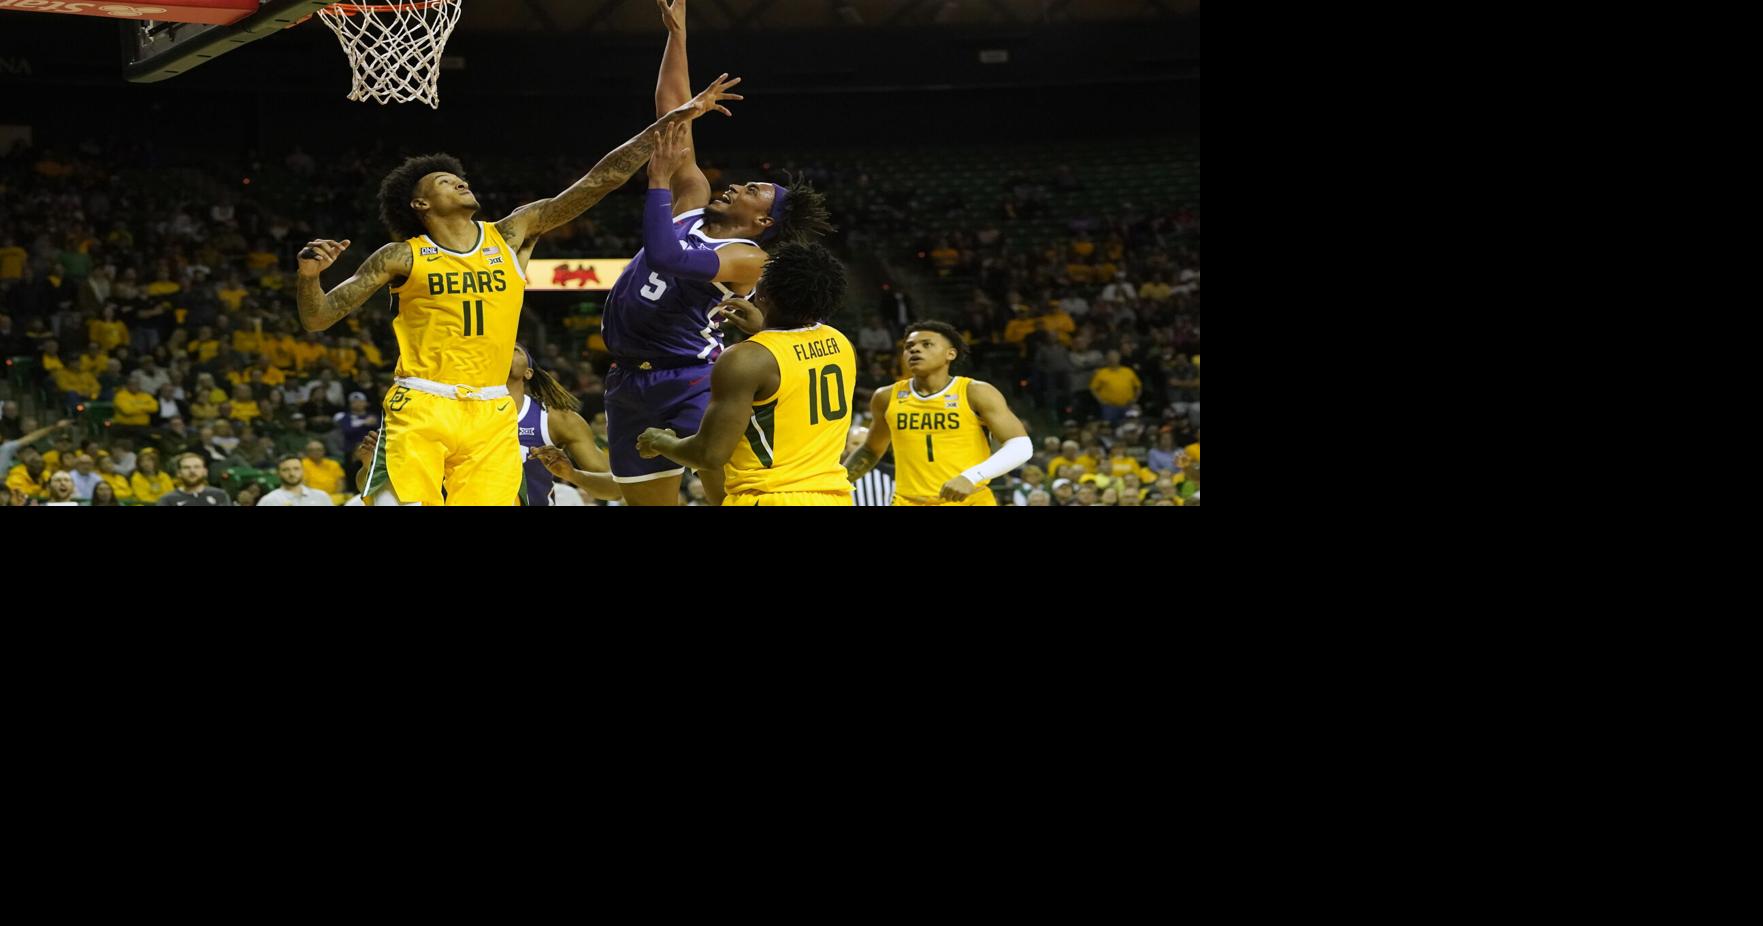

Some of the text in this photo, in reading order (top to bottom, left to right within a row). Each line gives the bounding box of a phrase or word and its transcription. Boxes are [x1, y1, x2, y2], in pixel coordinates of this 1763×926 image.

[427, 269, 507, 295] BEARS
[640, 271, 667, 301] 5
[462, 300, 484, 336] 11
[793, 337, 840, 361] FLAGLER
[389, 385, 411, 411] BU
[808, 363, 848, 425] 10
[897, 412, 960, 430] BEARS
[926, 434, 934, 462] 1
